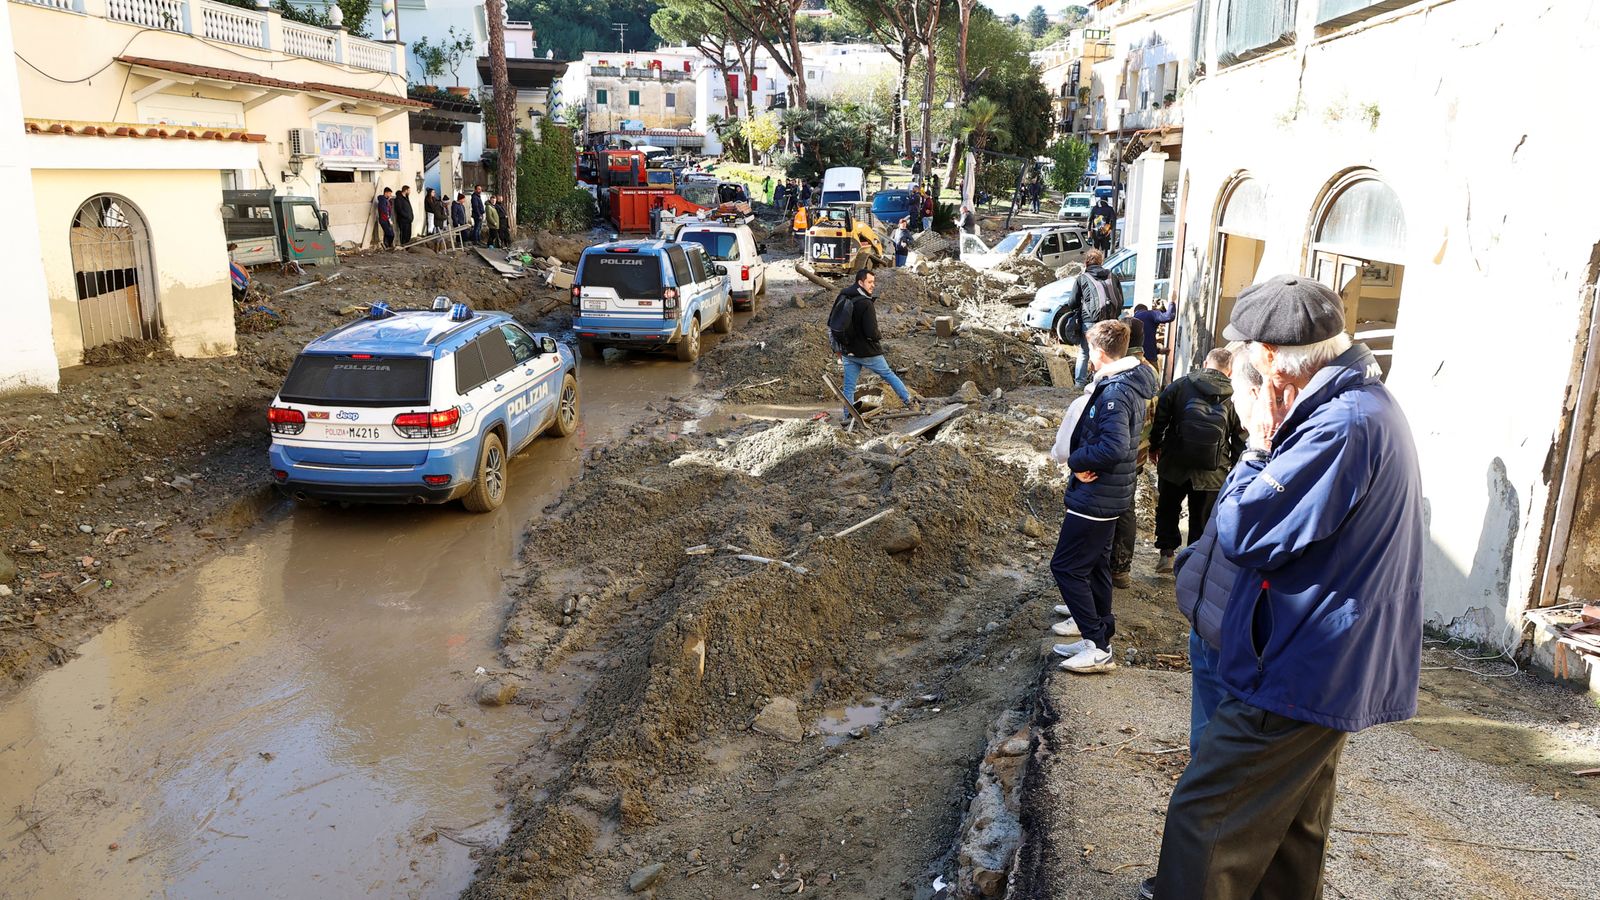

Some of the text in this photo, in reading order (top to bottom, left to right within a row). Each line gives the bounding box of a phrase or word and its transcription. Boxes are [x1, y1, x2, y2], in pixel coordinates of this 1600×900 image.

[812, 242, 837, 259] CAT
[507, 381, 549, 416] POLIZIA
[336, 410, 359, 421] Jeep
[325, 427, 380, 439] POLIZIA M4216
